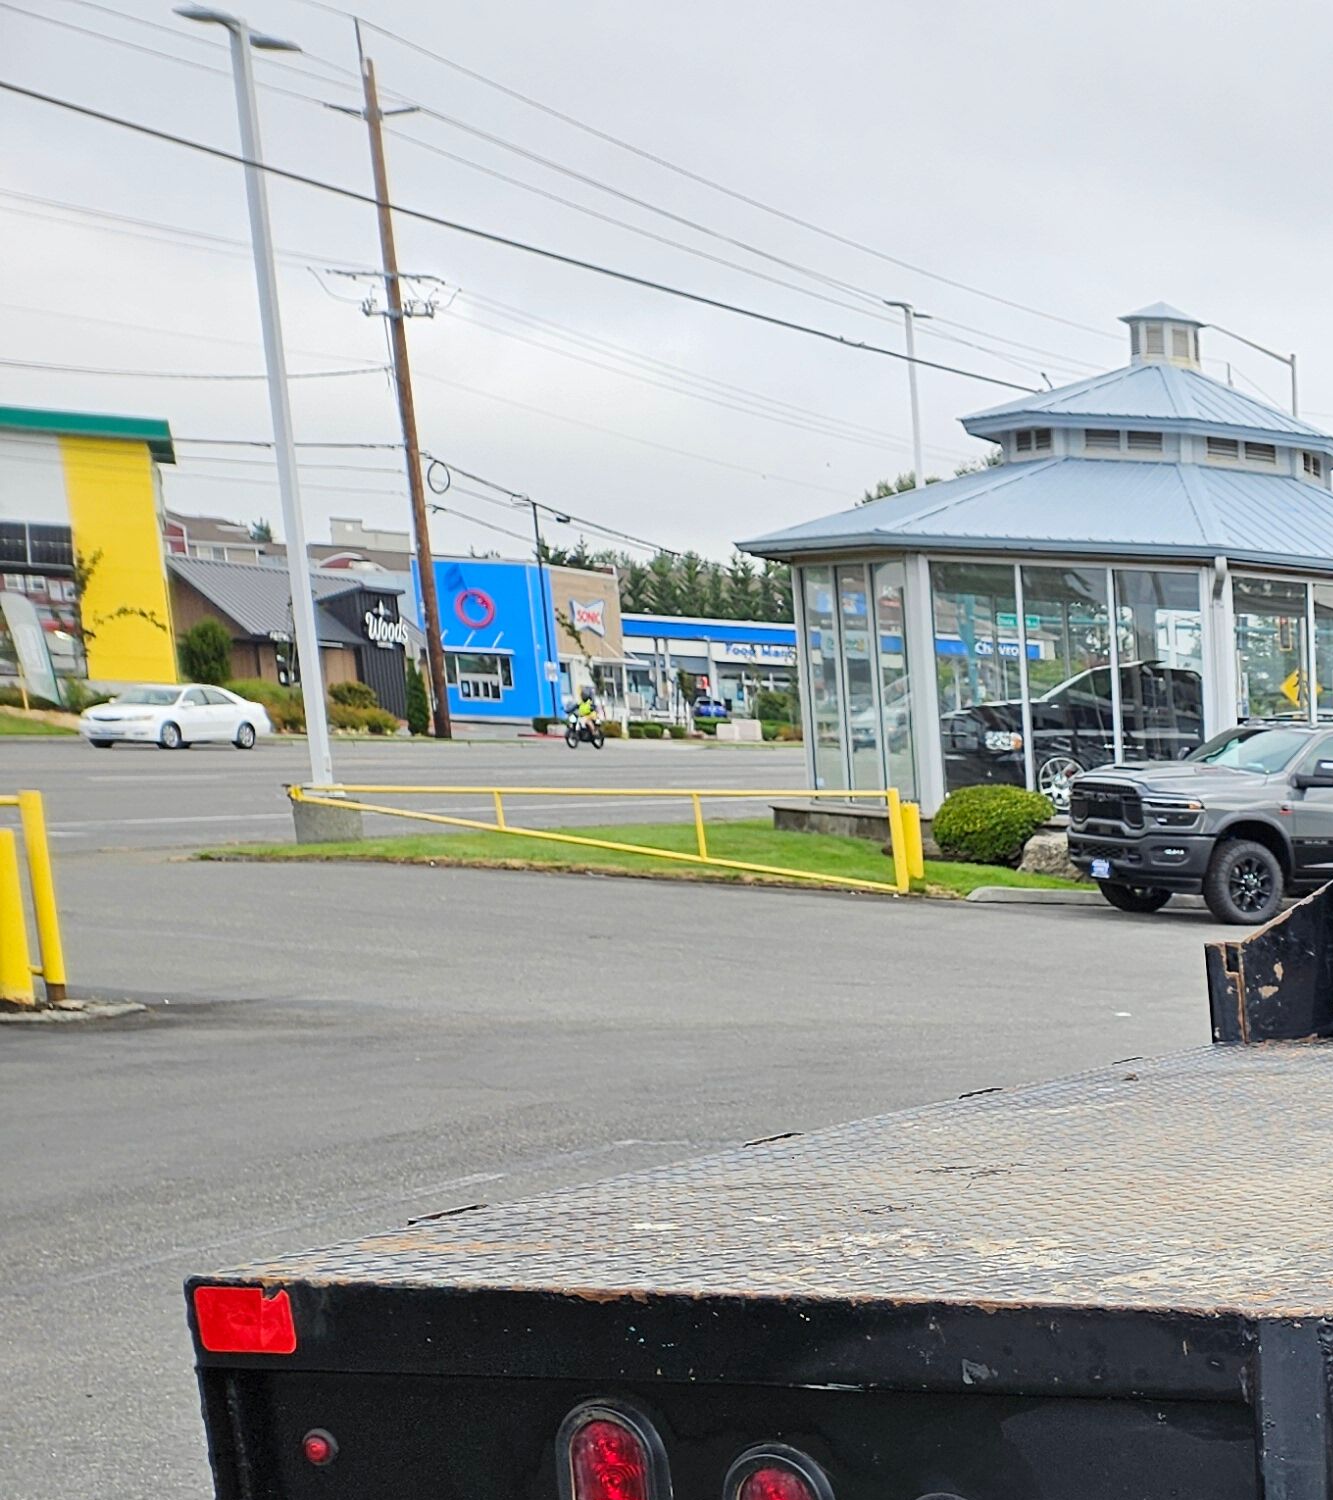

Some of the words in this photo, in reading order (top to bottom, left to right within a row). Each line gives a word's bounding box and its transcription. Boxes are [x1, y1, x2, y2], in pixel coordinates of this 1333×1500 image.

[576, 609, 601, 625] SONIC
[365, 611, 409, 643] Woods
[725, 641, 756, 656] Food
